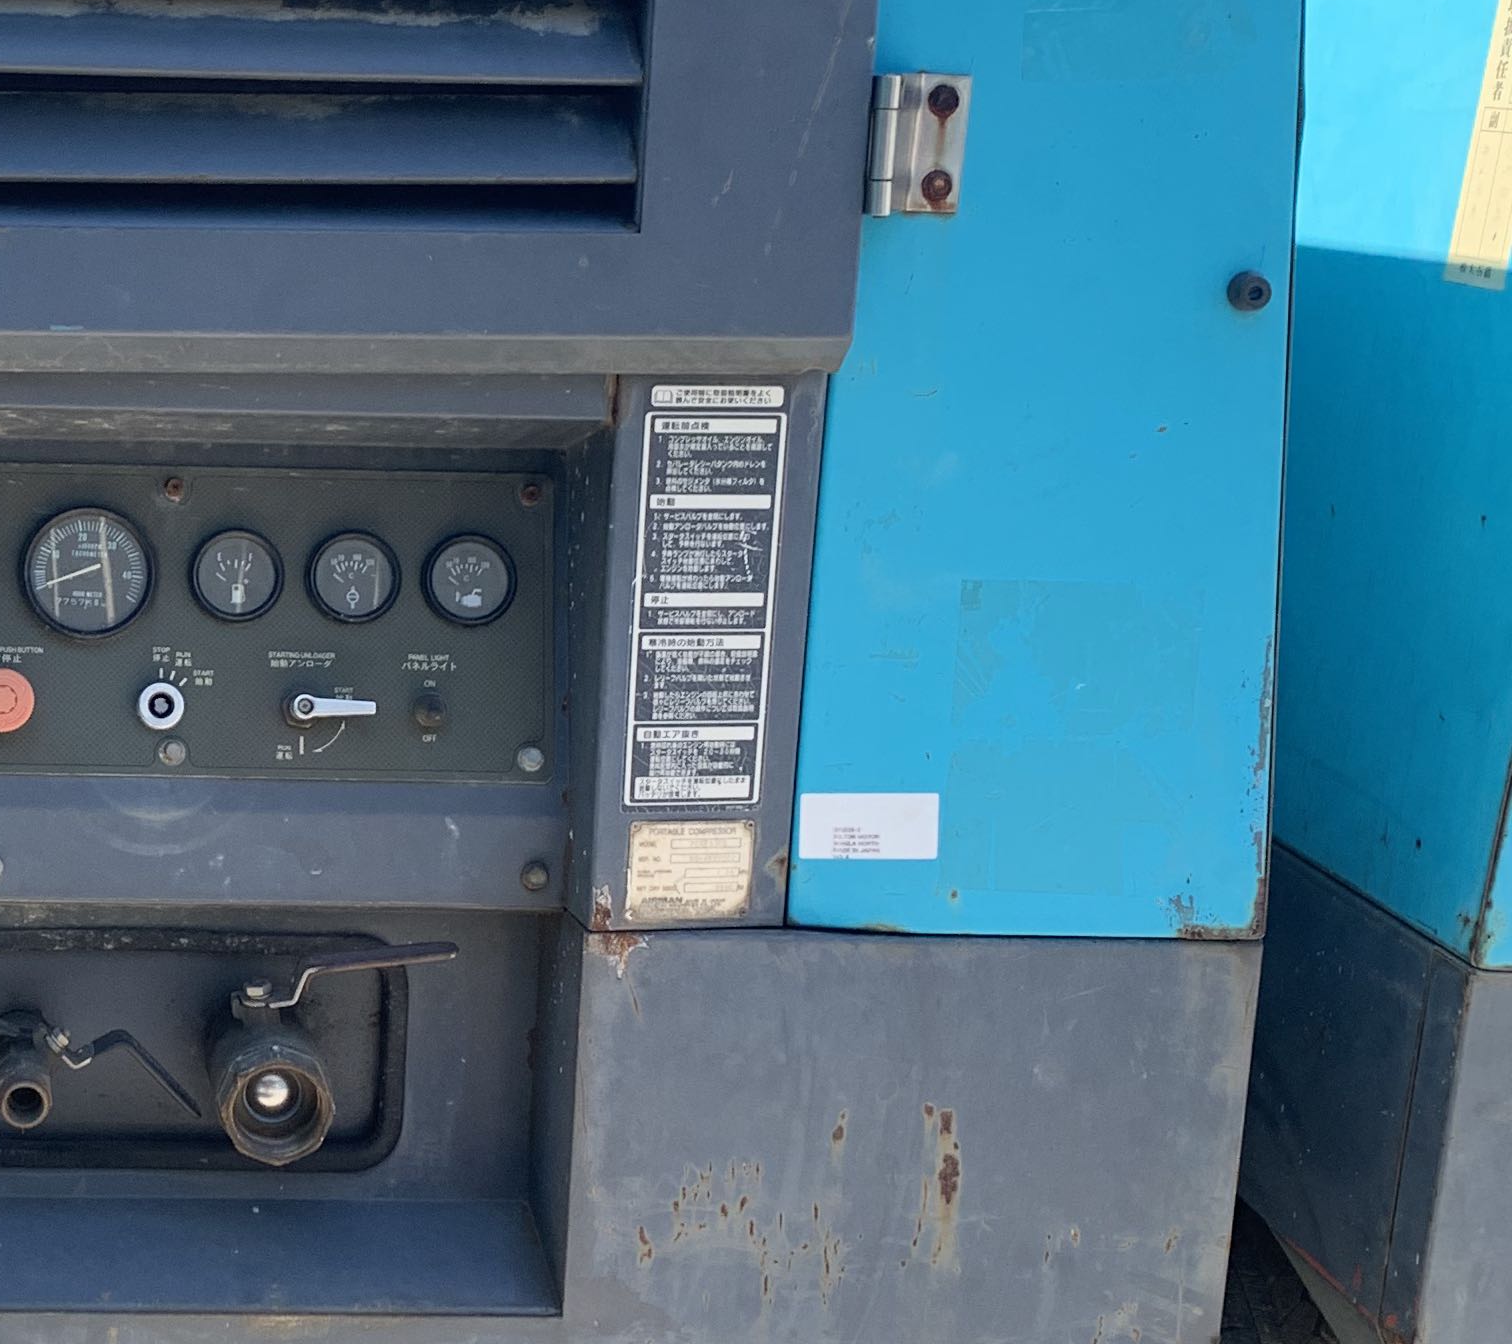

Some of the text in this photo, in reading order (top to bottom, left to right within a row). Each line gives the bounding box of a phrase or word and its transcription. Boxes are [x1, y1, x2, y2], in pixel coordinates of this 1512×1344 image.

[17, 646, 44, 655] BUTTON
[152, 646, 171, 654] STOP
[401, 662, 457, 671] パネルライト
[424, 679, 436, 688] ON
[422, 734, 437, 743] OFF
